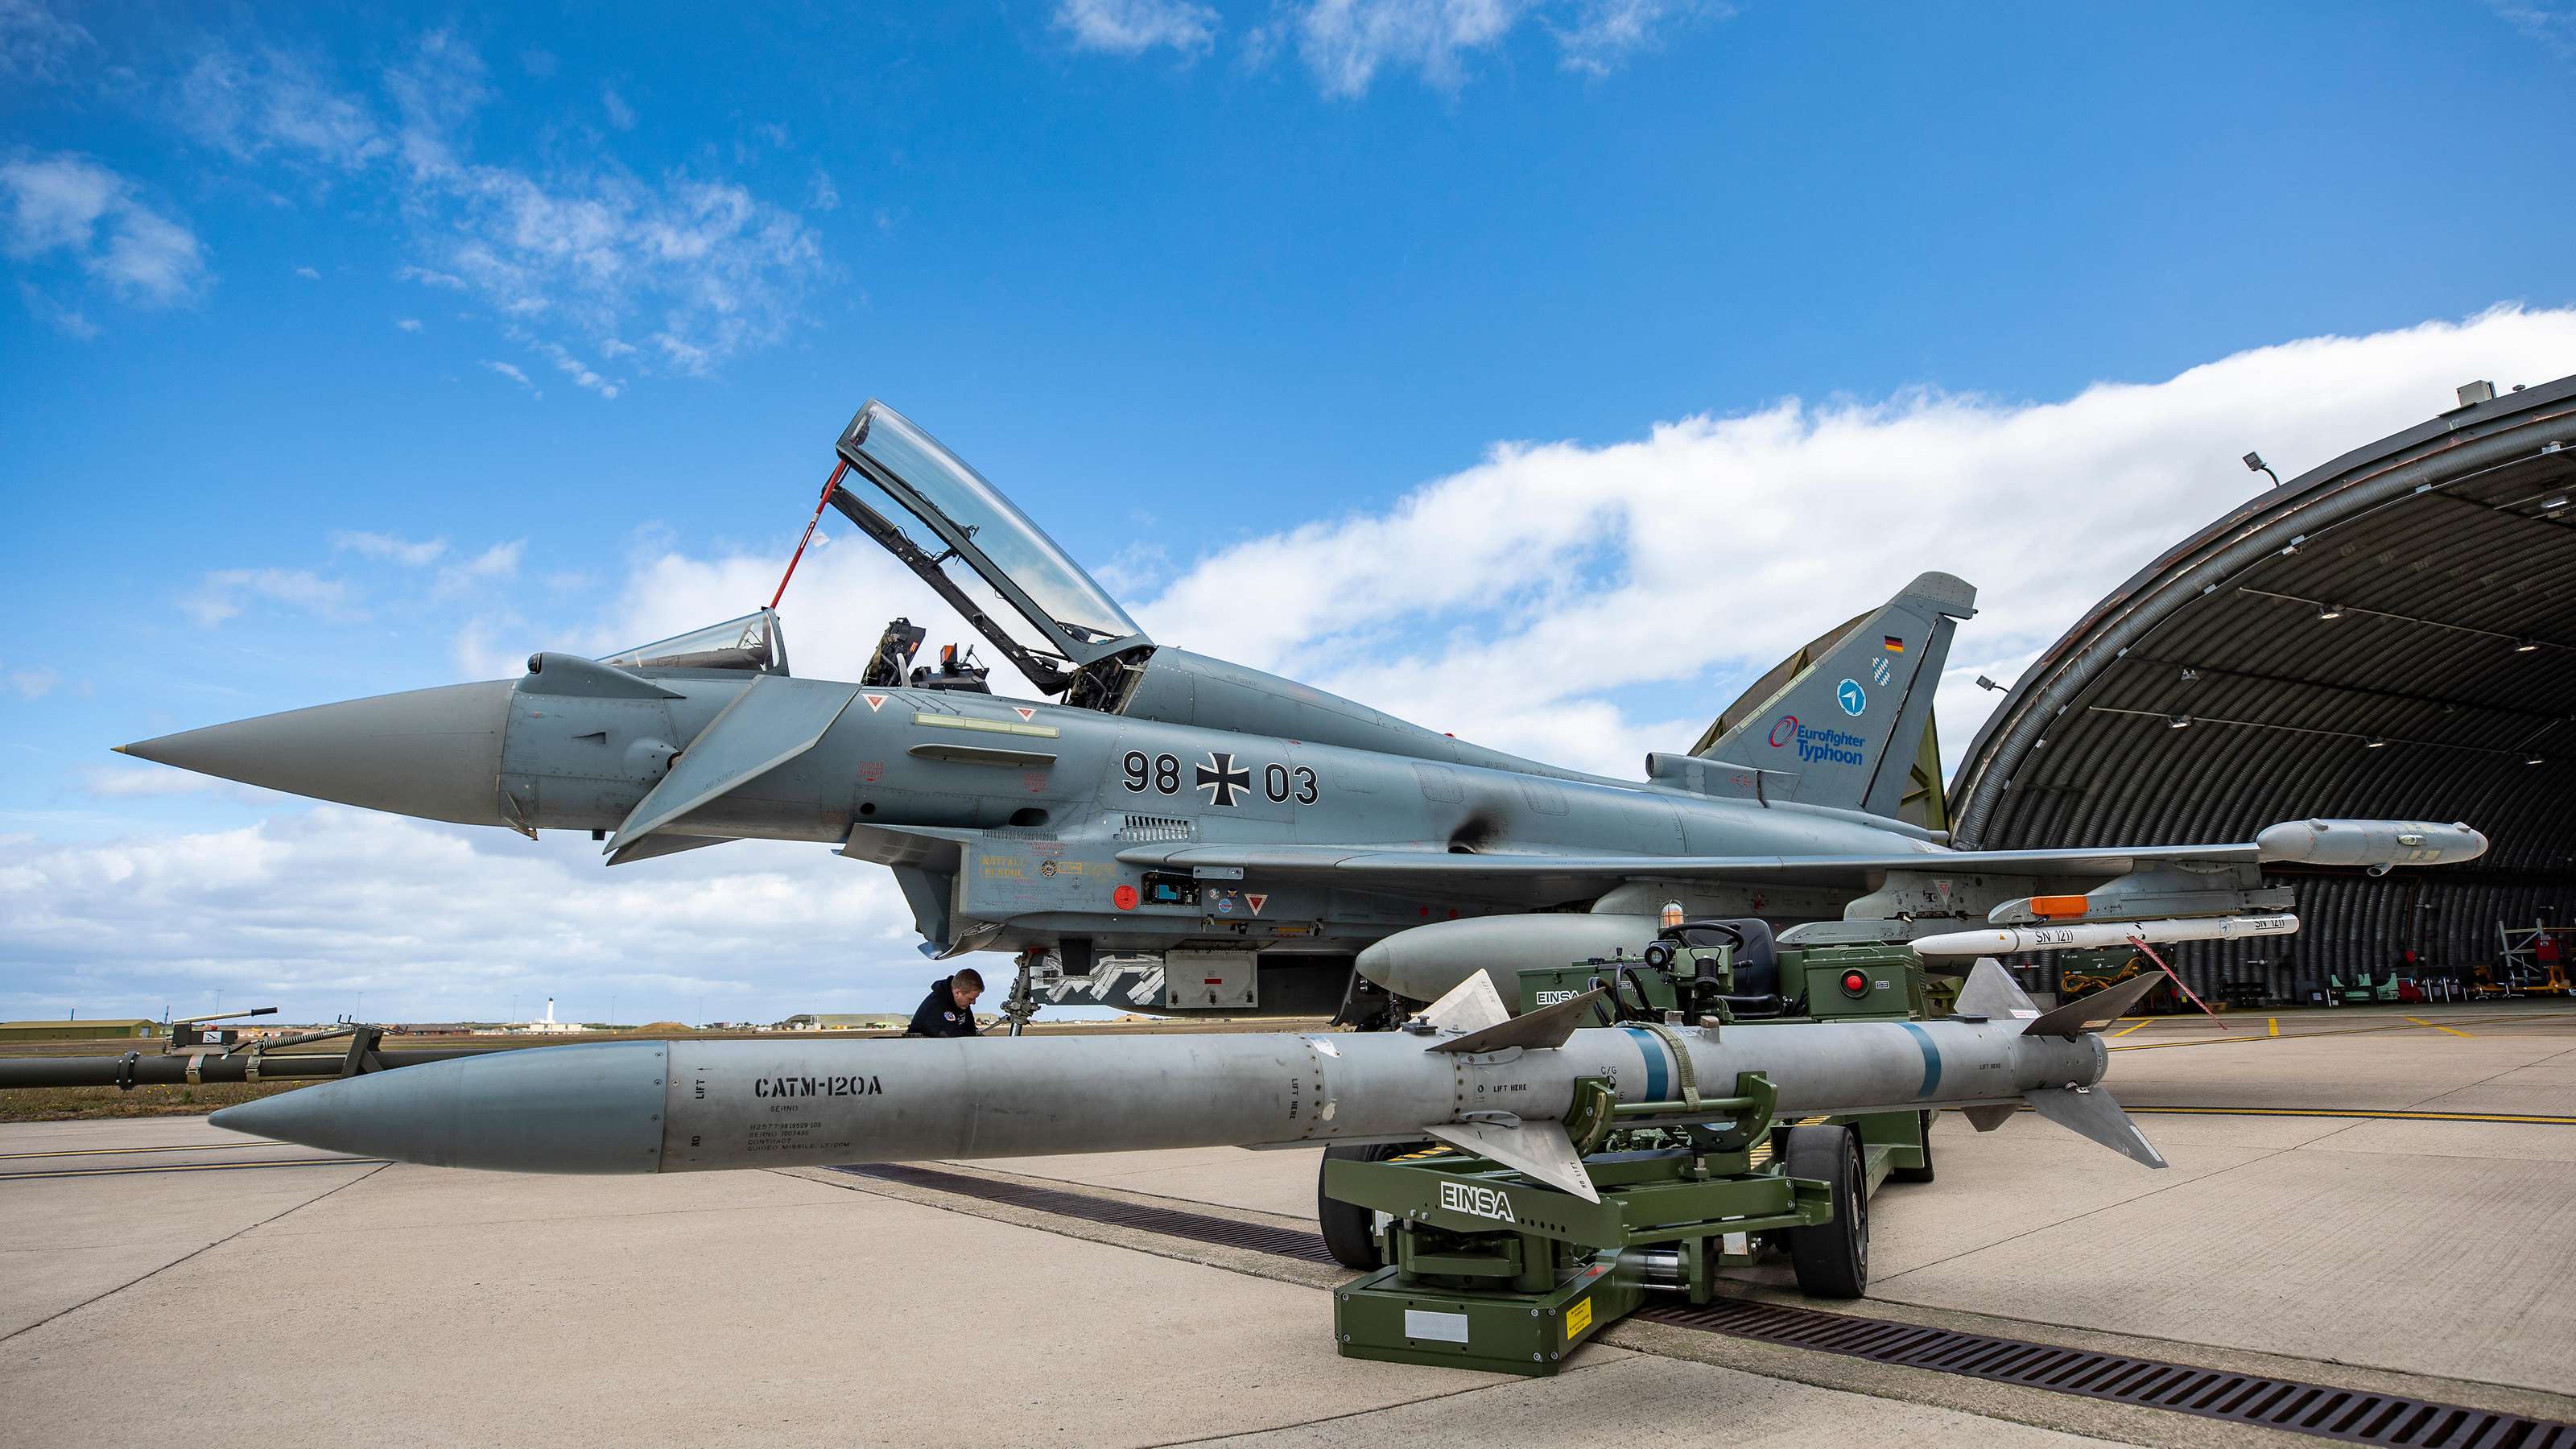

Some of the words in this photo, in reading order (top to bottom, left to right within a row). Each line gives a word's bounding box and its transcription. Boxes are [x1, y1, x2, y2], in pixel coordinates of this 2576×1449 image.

[1798, 725, 1865, 747] Eurofighter
[1797, 739, 1863, 765] Typhoon
[1122, 750, 1181, 795] 98
[1264, 763, 1319, 805] 03
[2035, 931, 2051, 943] SN
[2055, 930, 2074, 941] 1211
[1601, 1066, 1617, 1075] C/G
[695, 1080, 705, 1100] LIFT
[755, 1075, 882, 1097] CATM-120A
[1511, 1084, 1526, 1092] HERE
[1289, 1101, 1298, 1120] HERE
[747, 1137, 791, 1146] CONTRACT
[1441, 1181, 1515, 1223] EINSA
